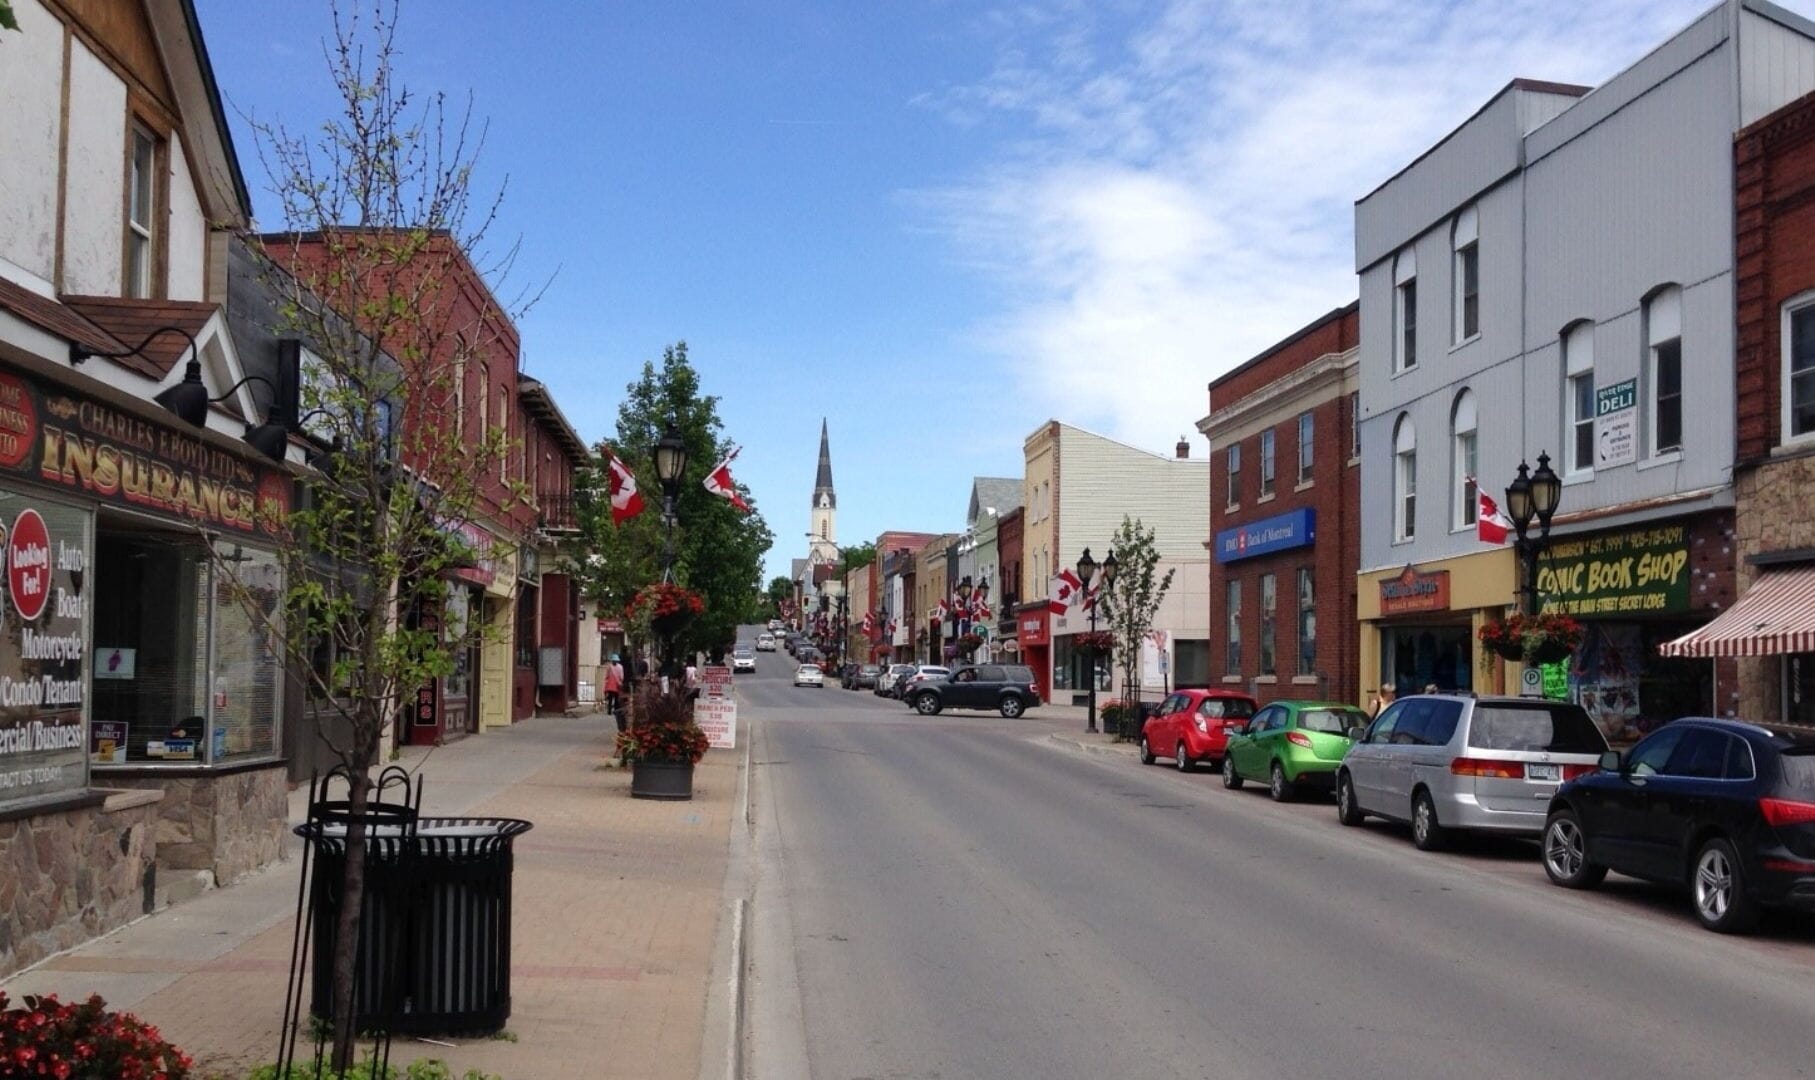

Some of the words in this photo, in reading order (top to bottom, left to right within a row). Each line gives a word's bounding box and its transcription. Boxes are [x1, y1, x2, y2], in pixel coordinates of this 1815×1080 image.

[1600, 392, 1632, 414] DELI
[79, 403, 155, 451] CHARLES
[41, 423, 254, 531] INSURANCE
[13, 542, 48, 570] Looking
[58, 540, 83, 571] Auto
[1537, 562, 1585, 598] COMIC
[1587, 556, 1634, 594] BOOK
[1637, 549, 1688, 587] SHOP
[57, 586, 82, 619] Boat
[1596, 597, 1618, 613] STREET
[1643, 593, 1667, 609] LODGE
[21, 627, 82, 668] Motorcycle
[21, 769, 33, 786] US
